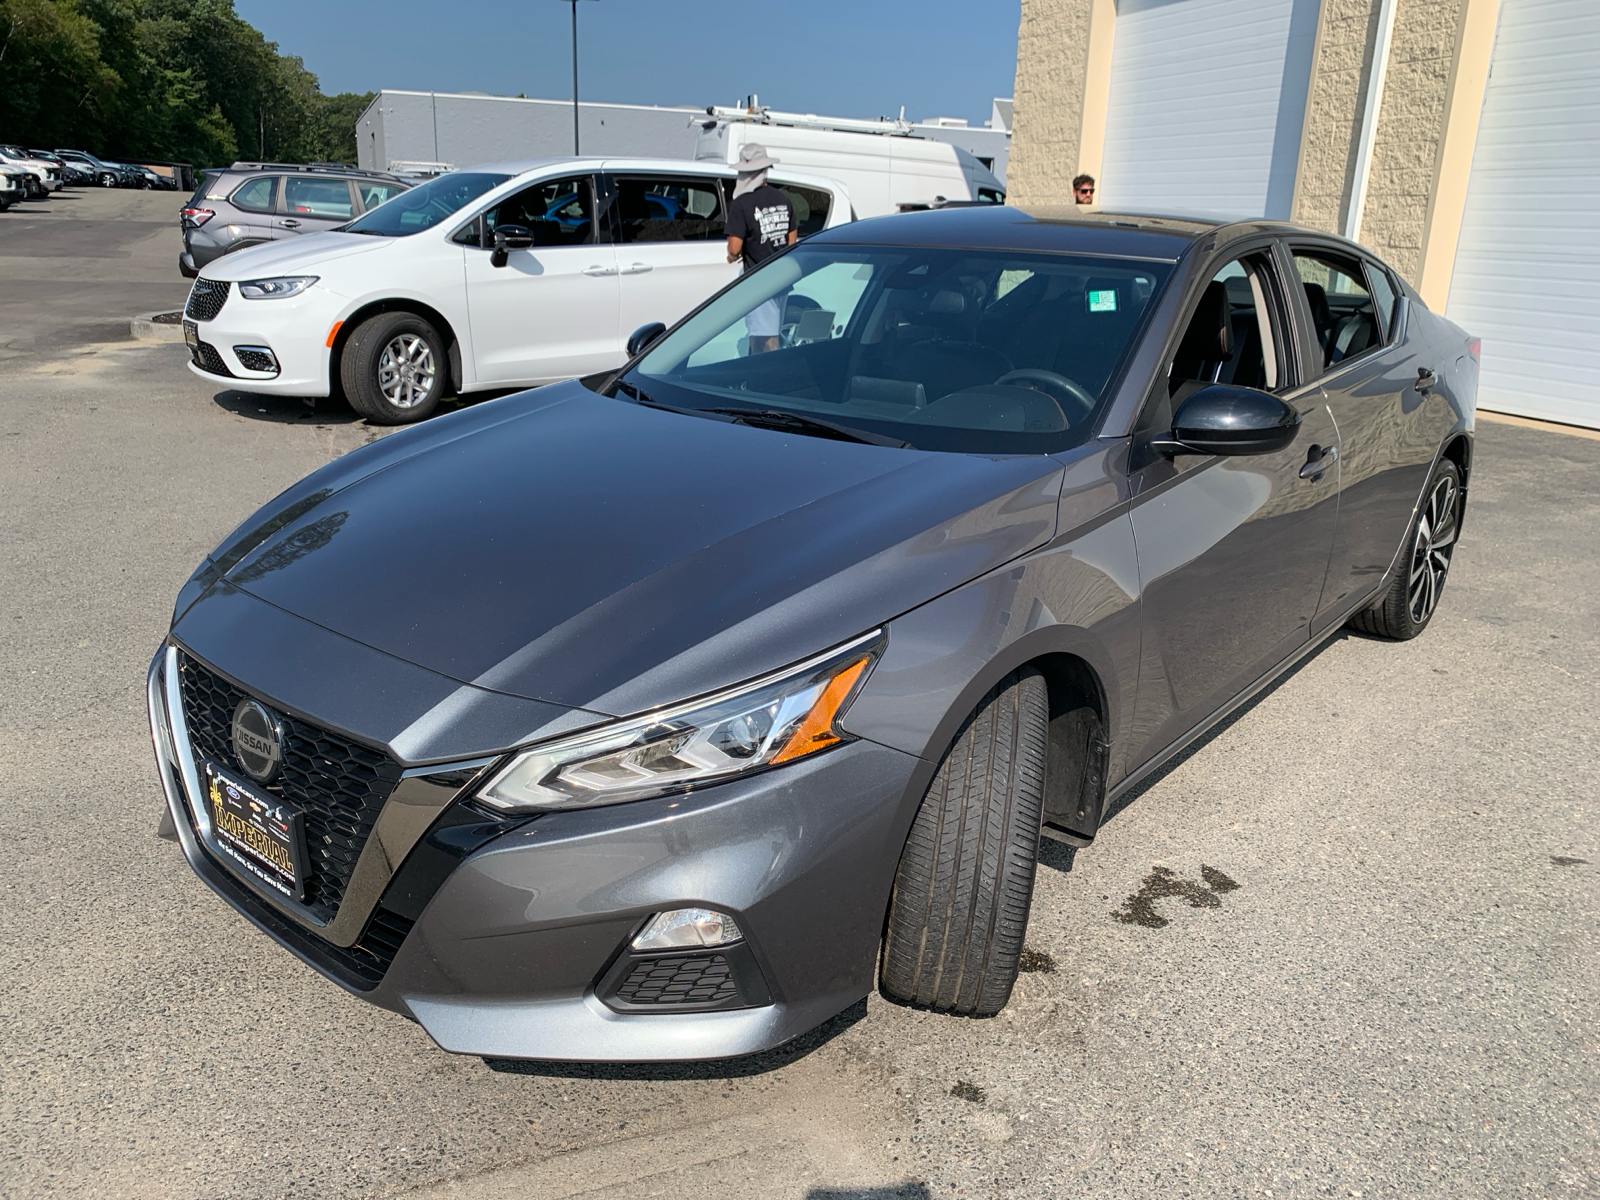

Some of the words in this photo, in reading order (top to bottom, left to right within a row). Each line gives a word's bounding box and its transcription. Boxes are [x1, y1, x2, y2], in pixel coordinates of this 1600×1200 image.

[237, 728, 272, 756] NISSAN
[214, 804, 295, 876] IMPERIAL
[217, 826, 296, 882] www.imperialcars.com
